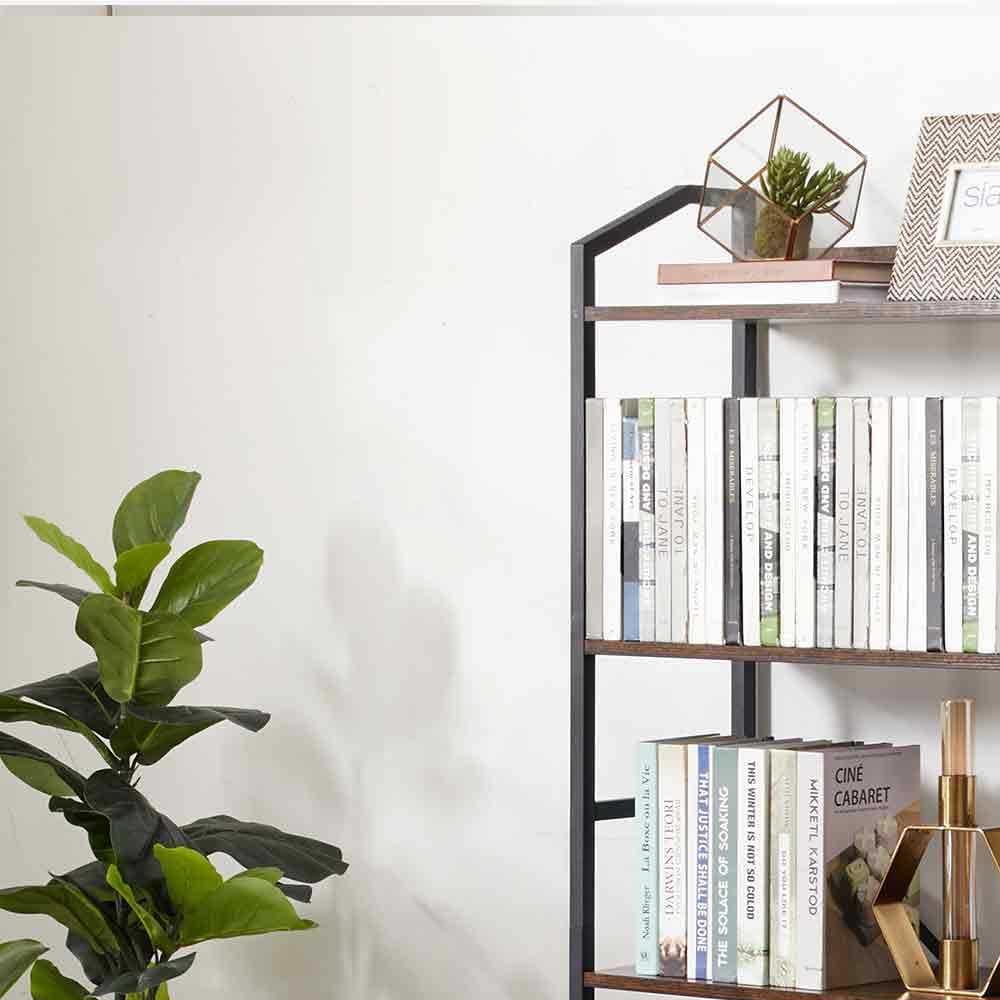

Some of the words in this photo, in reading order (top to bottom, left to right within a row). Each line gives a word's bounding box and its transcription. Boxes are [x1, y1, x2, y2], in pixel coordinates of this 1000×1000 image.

[641, 431, 651, 481] DESIGN
[820, 432, 830, 482] DESIGN
[641, 482, 651, 512] AND
[657, 488, 669, 510] TO
[820, 484, 830, 513] AND
[839, 489, 849, 511] TO
[947, 466, 958, 546] DEVELOP
[657, 512, 669, 561] JANE
[763, 531, 773, 559] AND
[839, 516, 849, 562] JANE
[967, 534, 977, 562] AND
[763, 561, 773, 612] DESIGN
[967, 566, 977, 617] DESIGN
[699, 771, 710, 805] THAT
[746, 760, 756, 785] THIS
[834, 763, 863, 784] CINÉ
[746, 786, 756, 828] WINTER
[808, 778, 819, 841] MIKKETL
[833, 786, 891, 807] CABARET
[717, 784, 729, 851] SOAKING
[641, 823, 650, 853] Boxe
[698, 808, 709, 860] JUSTICE
[746, 830, 756, 841] IS
[641, 856, 650, 873] La
[717, 855, 728, 876] OF
[746, 845, 756, 865] NOT
[663, 847, 674, 915] DARWINS
[697, 863, 708, 901] SHALL
[746, 868, 756, 883] SO
[808, 847, 819, 917] KARSTOD
[697, 902, 707, 917] BE
[716, 880, 728, 936] SOLACE
[696, 919, 707, 952] DONE
[716, 940, 728, 968] THE
